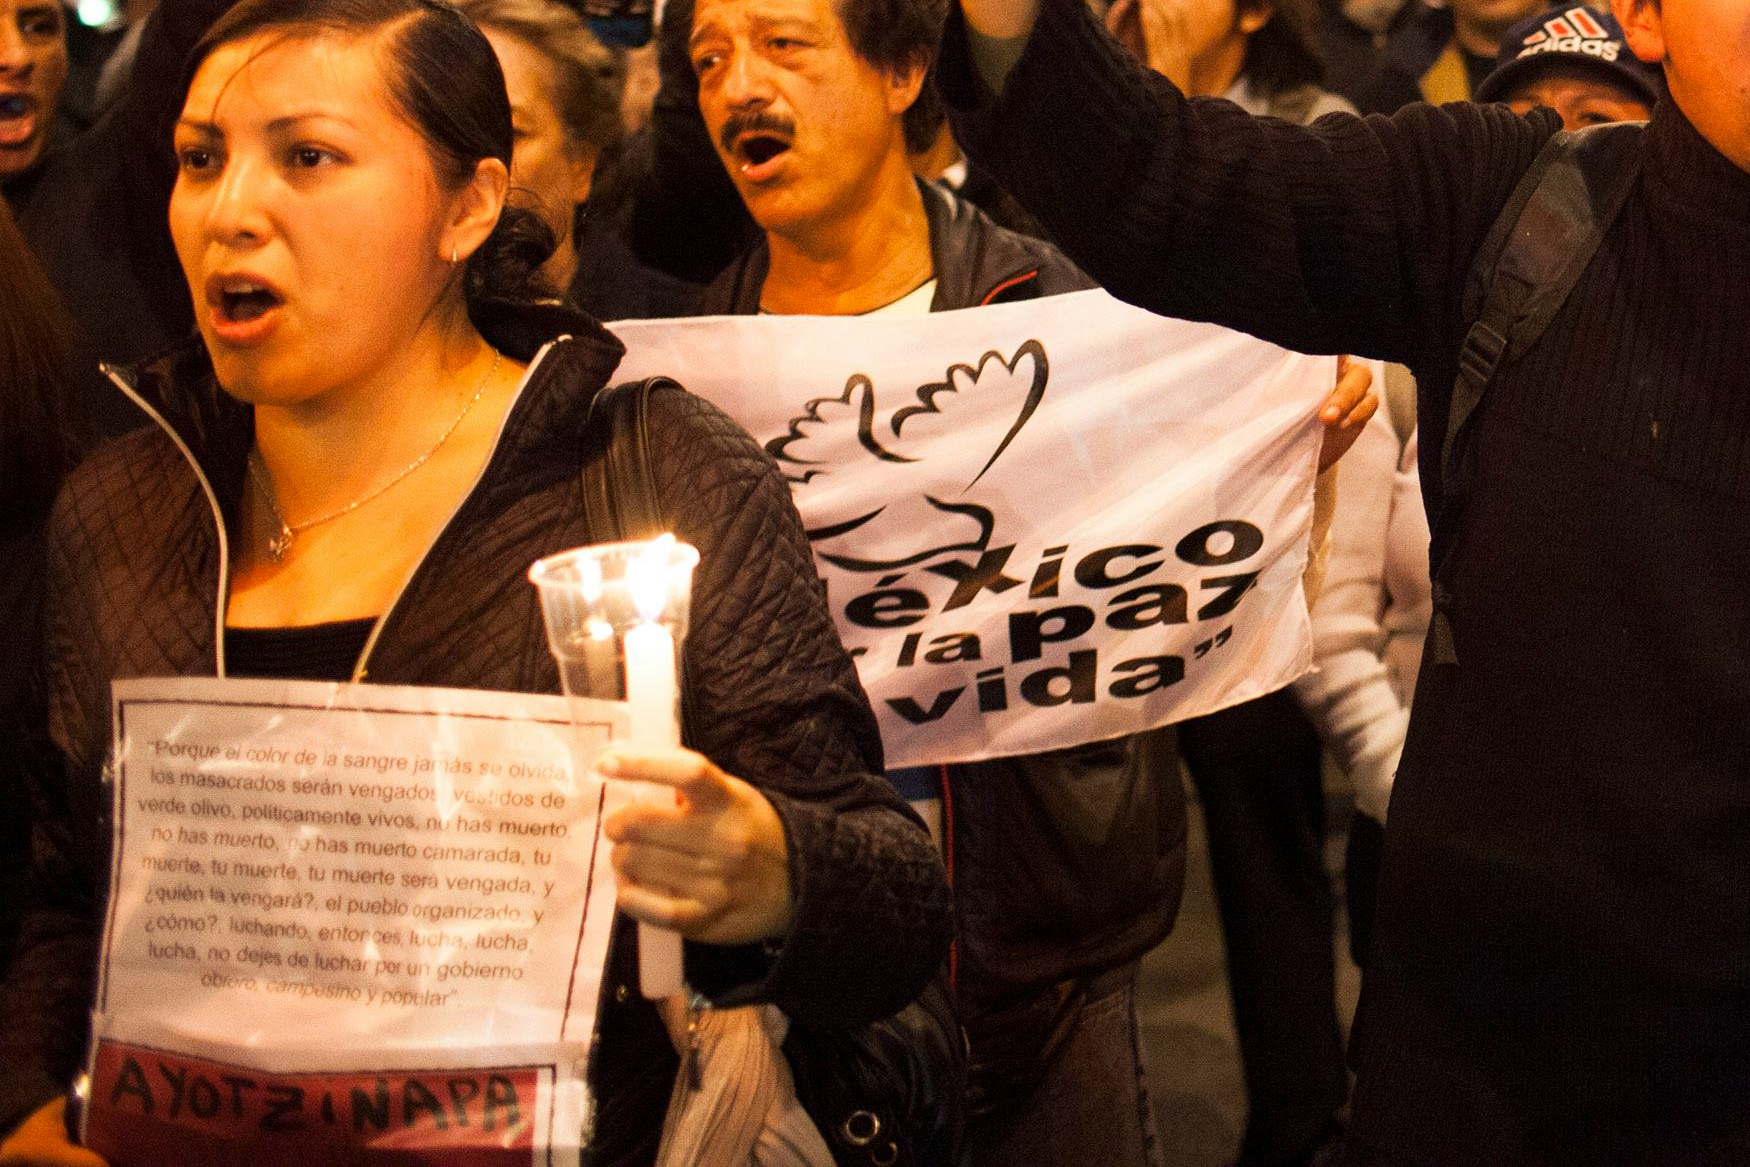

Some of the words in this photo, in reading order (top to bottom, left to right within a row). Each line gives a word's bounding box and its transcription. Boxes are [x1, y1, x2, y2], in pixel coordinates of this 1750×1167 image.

[820, 519, 1265, 631] éxico
[896, 631, 983, 669] la
[225, 745, 239, 761] el
[246, 746, 290, 764] color
[294, 748, 317, 766] de
[343, 753, 409, 774] sangre
[479, 762, 503, 777] se
[149, 768, 175, 785] los
[180, 770, 286, 794] masacrados
[292, 779, 343, 798] serán
[540, 791, 566, 810] de
[137, 795, 187, 815] verde
[456, 815, 493, 834] has
[151, 826, 173, 843] no
[177, 825, 209, 845] has
[213, 831, 280, 852] muerto,
[314, 835, 349, 855] has
[354, 839, 418, 860] muerto
[422, 843, 526, 866] camarada,
[532, 848, 552, 867] tu
[211, 859, 228, 877] tu
[307, 864, 325, 883] tu
[331, 866, 395, 887] muerte
[445, 875, 537, 897] vengada,
[543, 880, 555, 899] y
[209, 886, 226, 904] la
[325, 894, 342, 912] el
[346, 895, 409, 916] pueblo
[533, 909, 546, 927] y
[475, 932, 534, 955] lucha,
[207, 946, 231, 963] no
[236, 945, 282, 969] dejes
[287, 950, 309, 969] de
[314, 951, 368, 973] luchar
[436, 960, 524, 983] gobierno
[366, 987, 378, 1008] y
